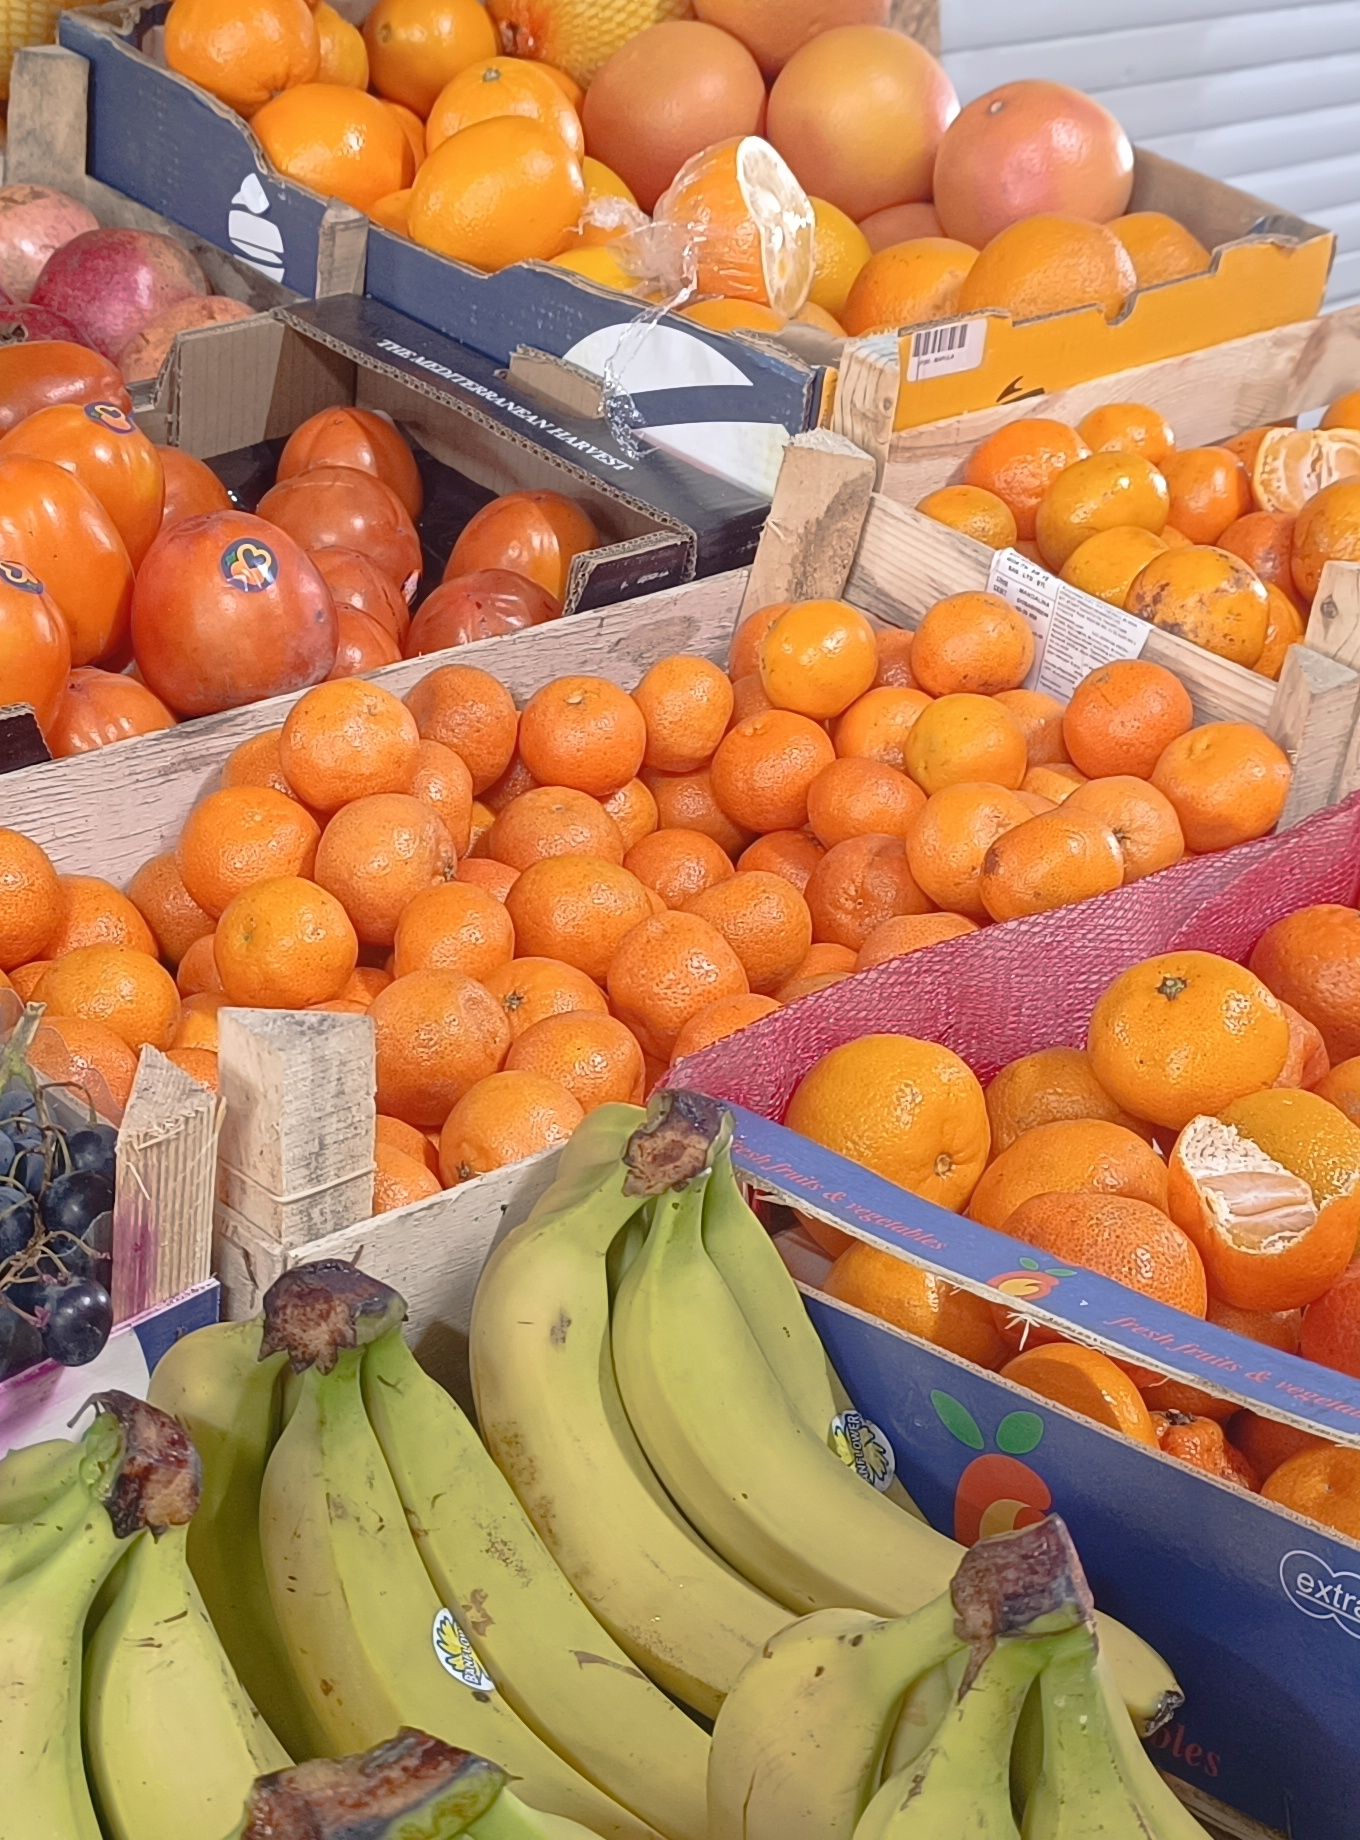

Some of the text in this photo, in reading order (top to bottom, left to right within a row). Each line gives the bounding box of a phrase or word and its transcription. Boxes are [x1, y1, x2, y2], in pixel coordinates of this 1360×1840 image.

[377, 339, 633, 472] THE MEDITERRANEAN HARVEST
[763, 1163, 824, 1192] fruits
[823, 1191, 845, 1205] &
[846, 1200, 948, 1251] vegetables
[1105, 1316, 1174, 1347] fresh
[1169, 1342, 1239, 1374] fruits
[1243, 1369, 1273, 1385] &
